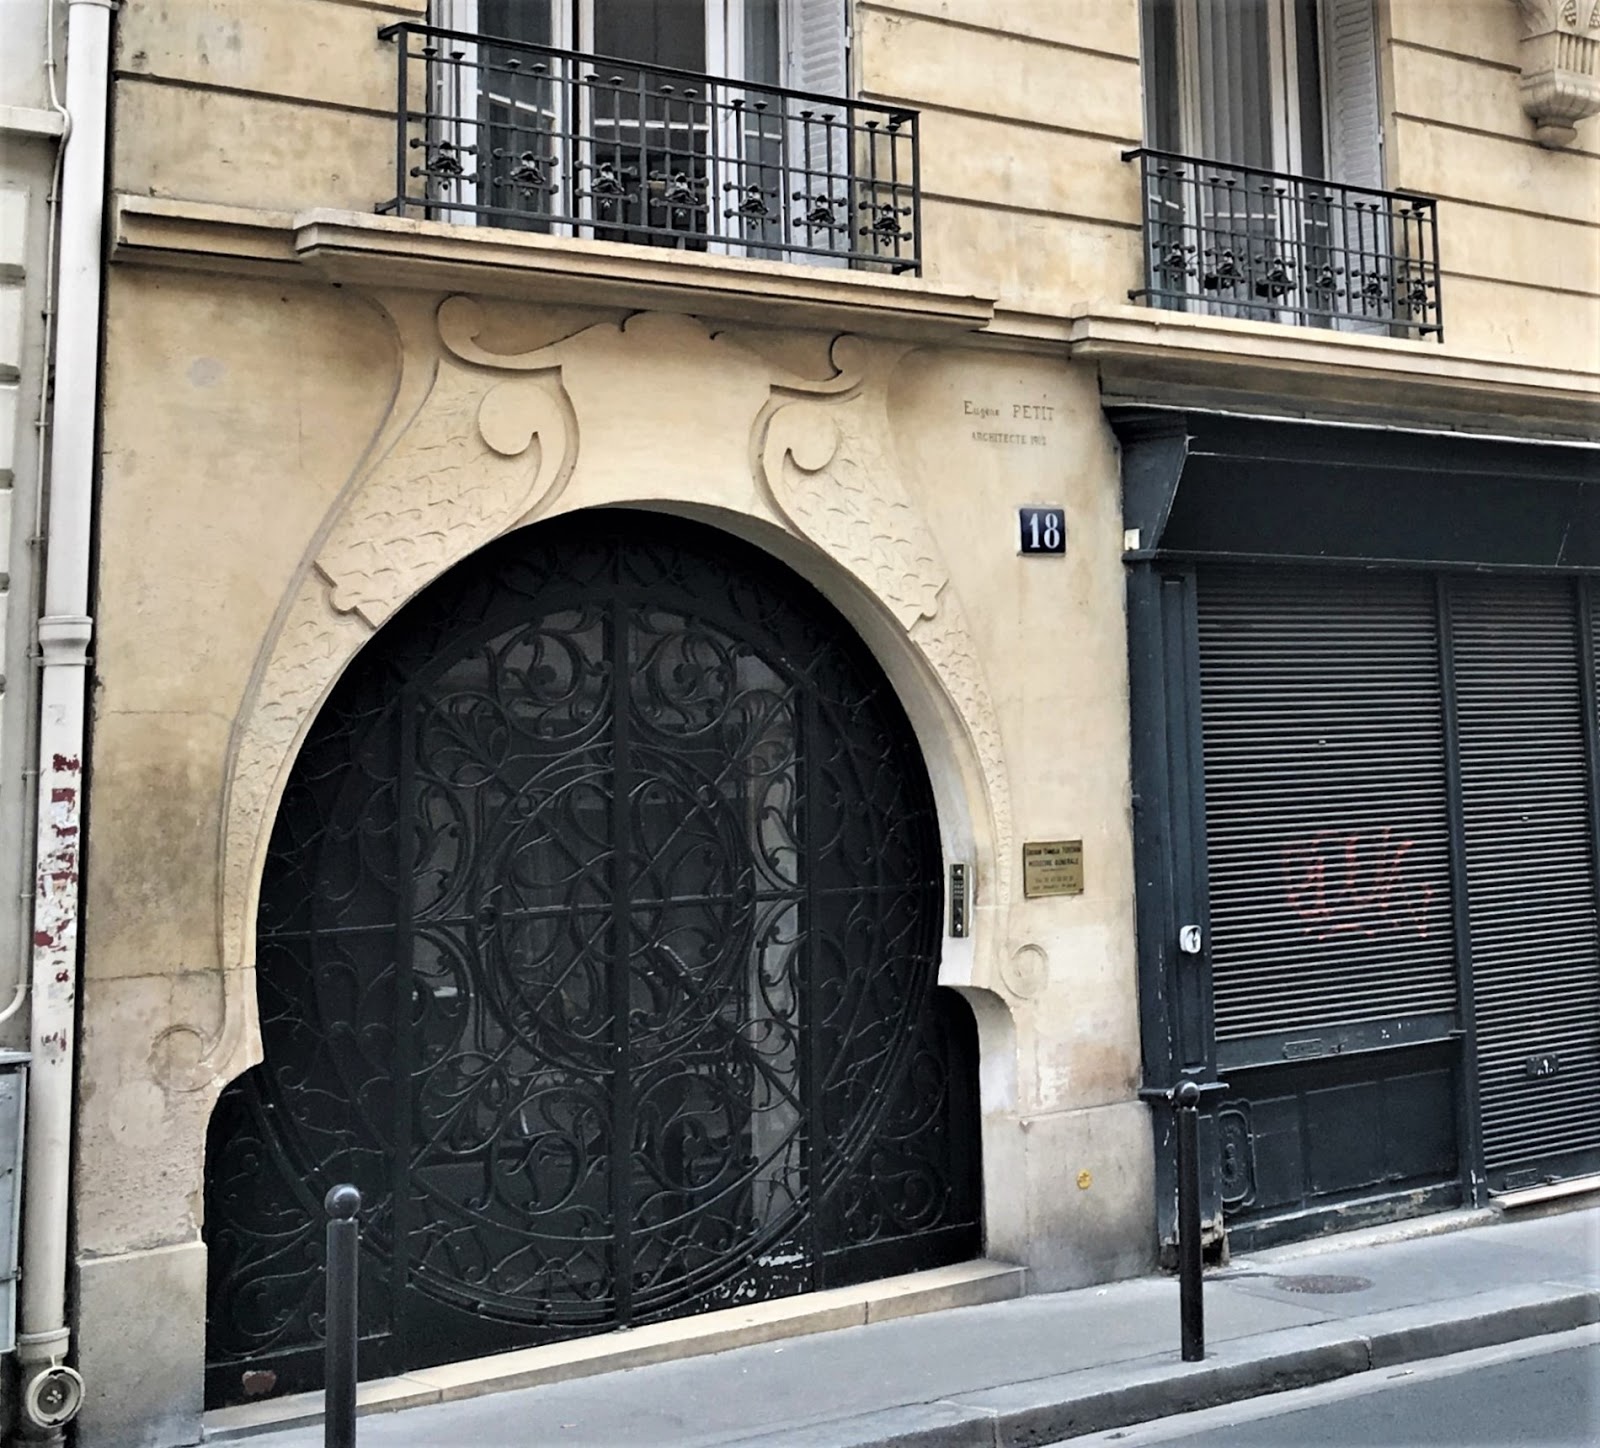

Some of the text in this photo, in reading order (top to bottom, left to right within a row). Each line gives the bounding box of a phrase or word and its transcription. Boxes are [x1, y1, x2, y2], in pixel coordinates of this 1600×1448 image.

[1012, 404, 1055, 421] PETIT
[971, 431, 1027, 445] ARCHITECTE
[1029, 512, 1060, 549] 18
